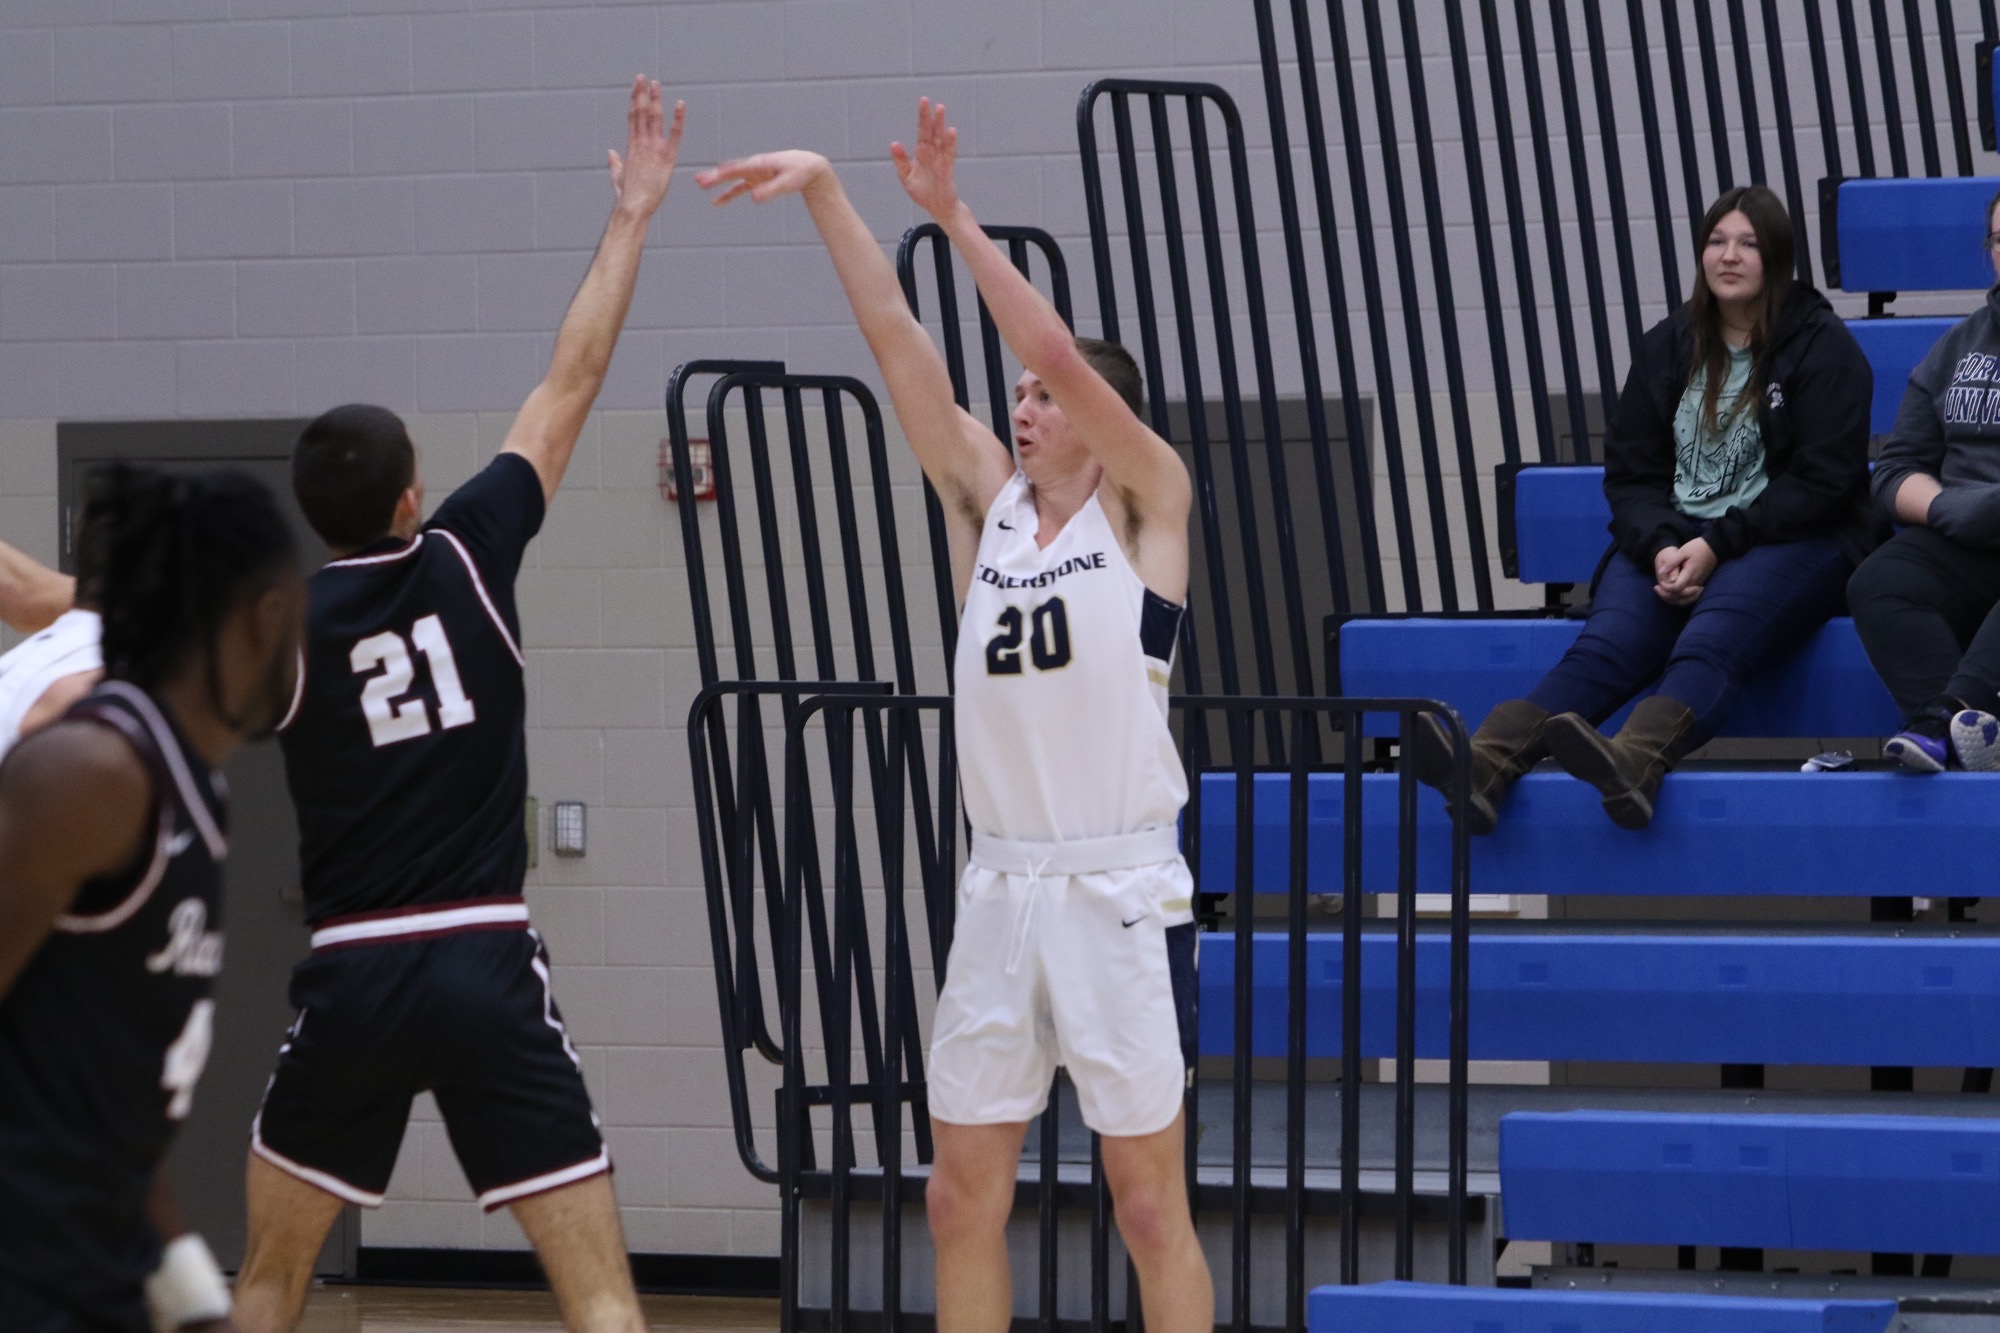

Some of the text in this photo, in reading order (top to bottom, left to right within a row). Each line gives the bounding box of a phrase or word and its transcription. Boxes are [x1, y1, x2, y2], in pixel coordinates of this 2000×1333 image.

[977, 552, 1107, 589] OERSTONE
[985, 595, 1072, 676] 20
[349, 613, 476, 748] 21
